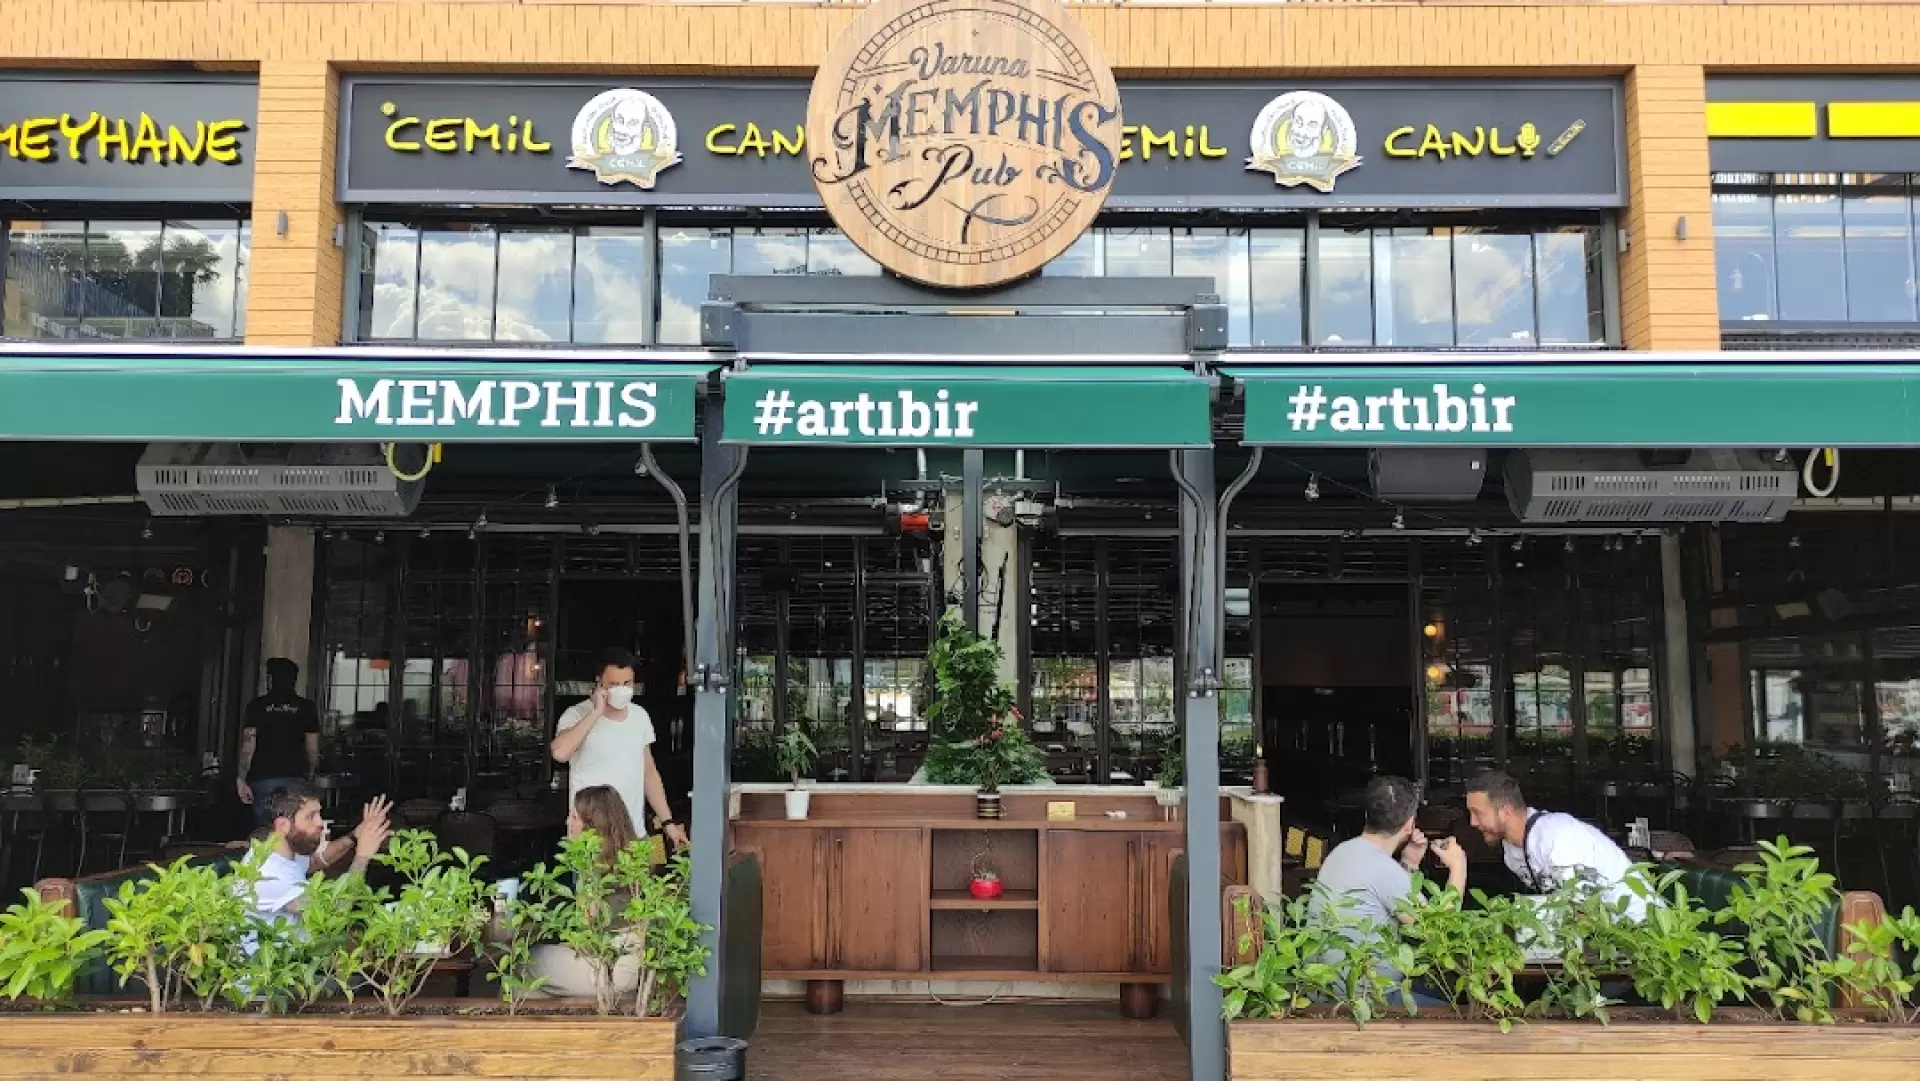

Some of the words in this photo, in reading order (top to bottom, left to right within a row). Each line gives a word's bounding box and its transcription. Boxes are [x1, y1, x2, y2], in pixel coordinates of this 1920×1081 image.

[909, 42, 1030, 80] Varuna
[705, 122, 805, 157] CAN
[812, 79, 1117, 193] MEMPHIS
[888, 144, 1022, 210] Pub
[334, 378, 658, 428] MEMPHIS
